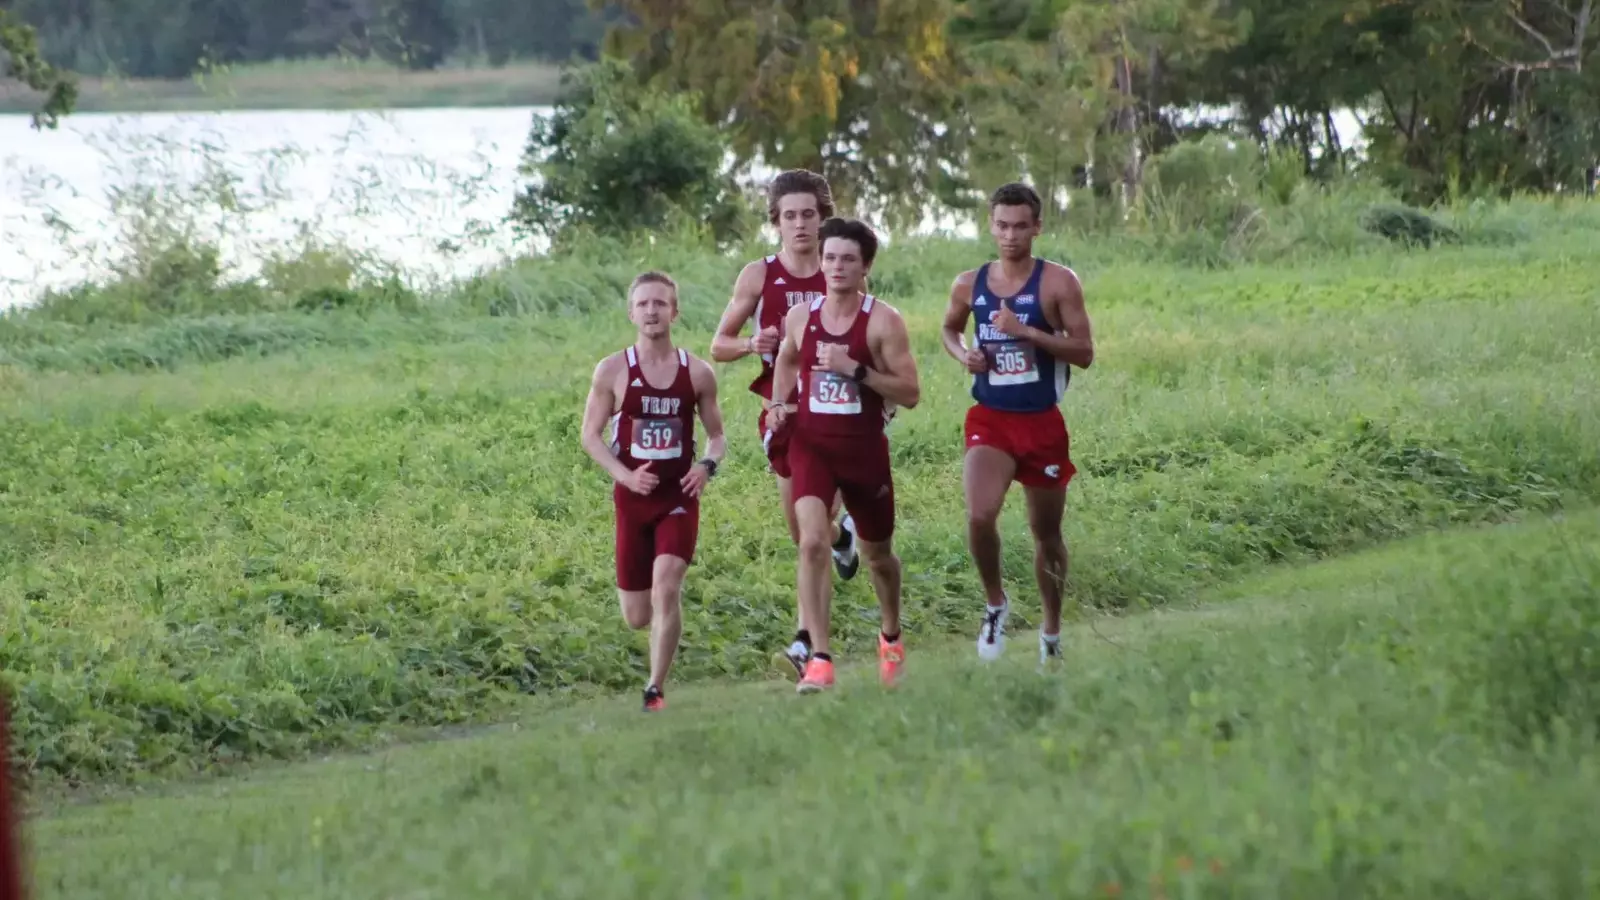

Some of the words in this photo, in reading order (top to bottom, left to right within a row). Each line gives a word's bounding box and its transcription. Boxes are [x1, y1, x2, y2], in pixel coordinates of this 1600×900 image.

[996, 352, 1025, 372] 505
[819, 381, 849, 402] 524
[641, 395, 681, 415] TROY
[642, 427, 673, 448] 519
